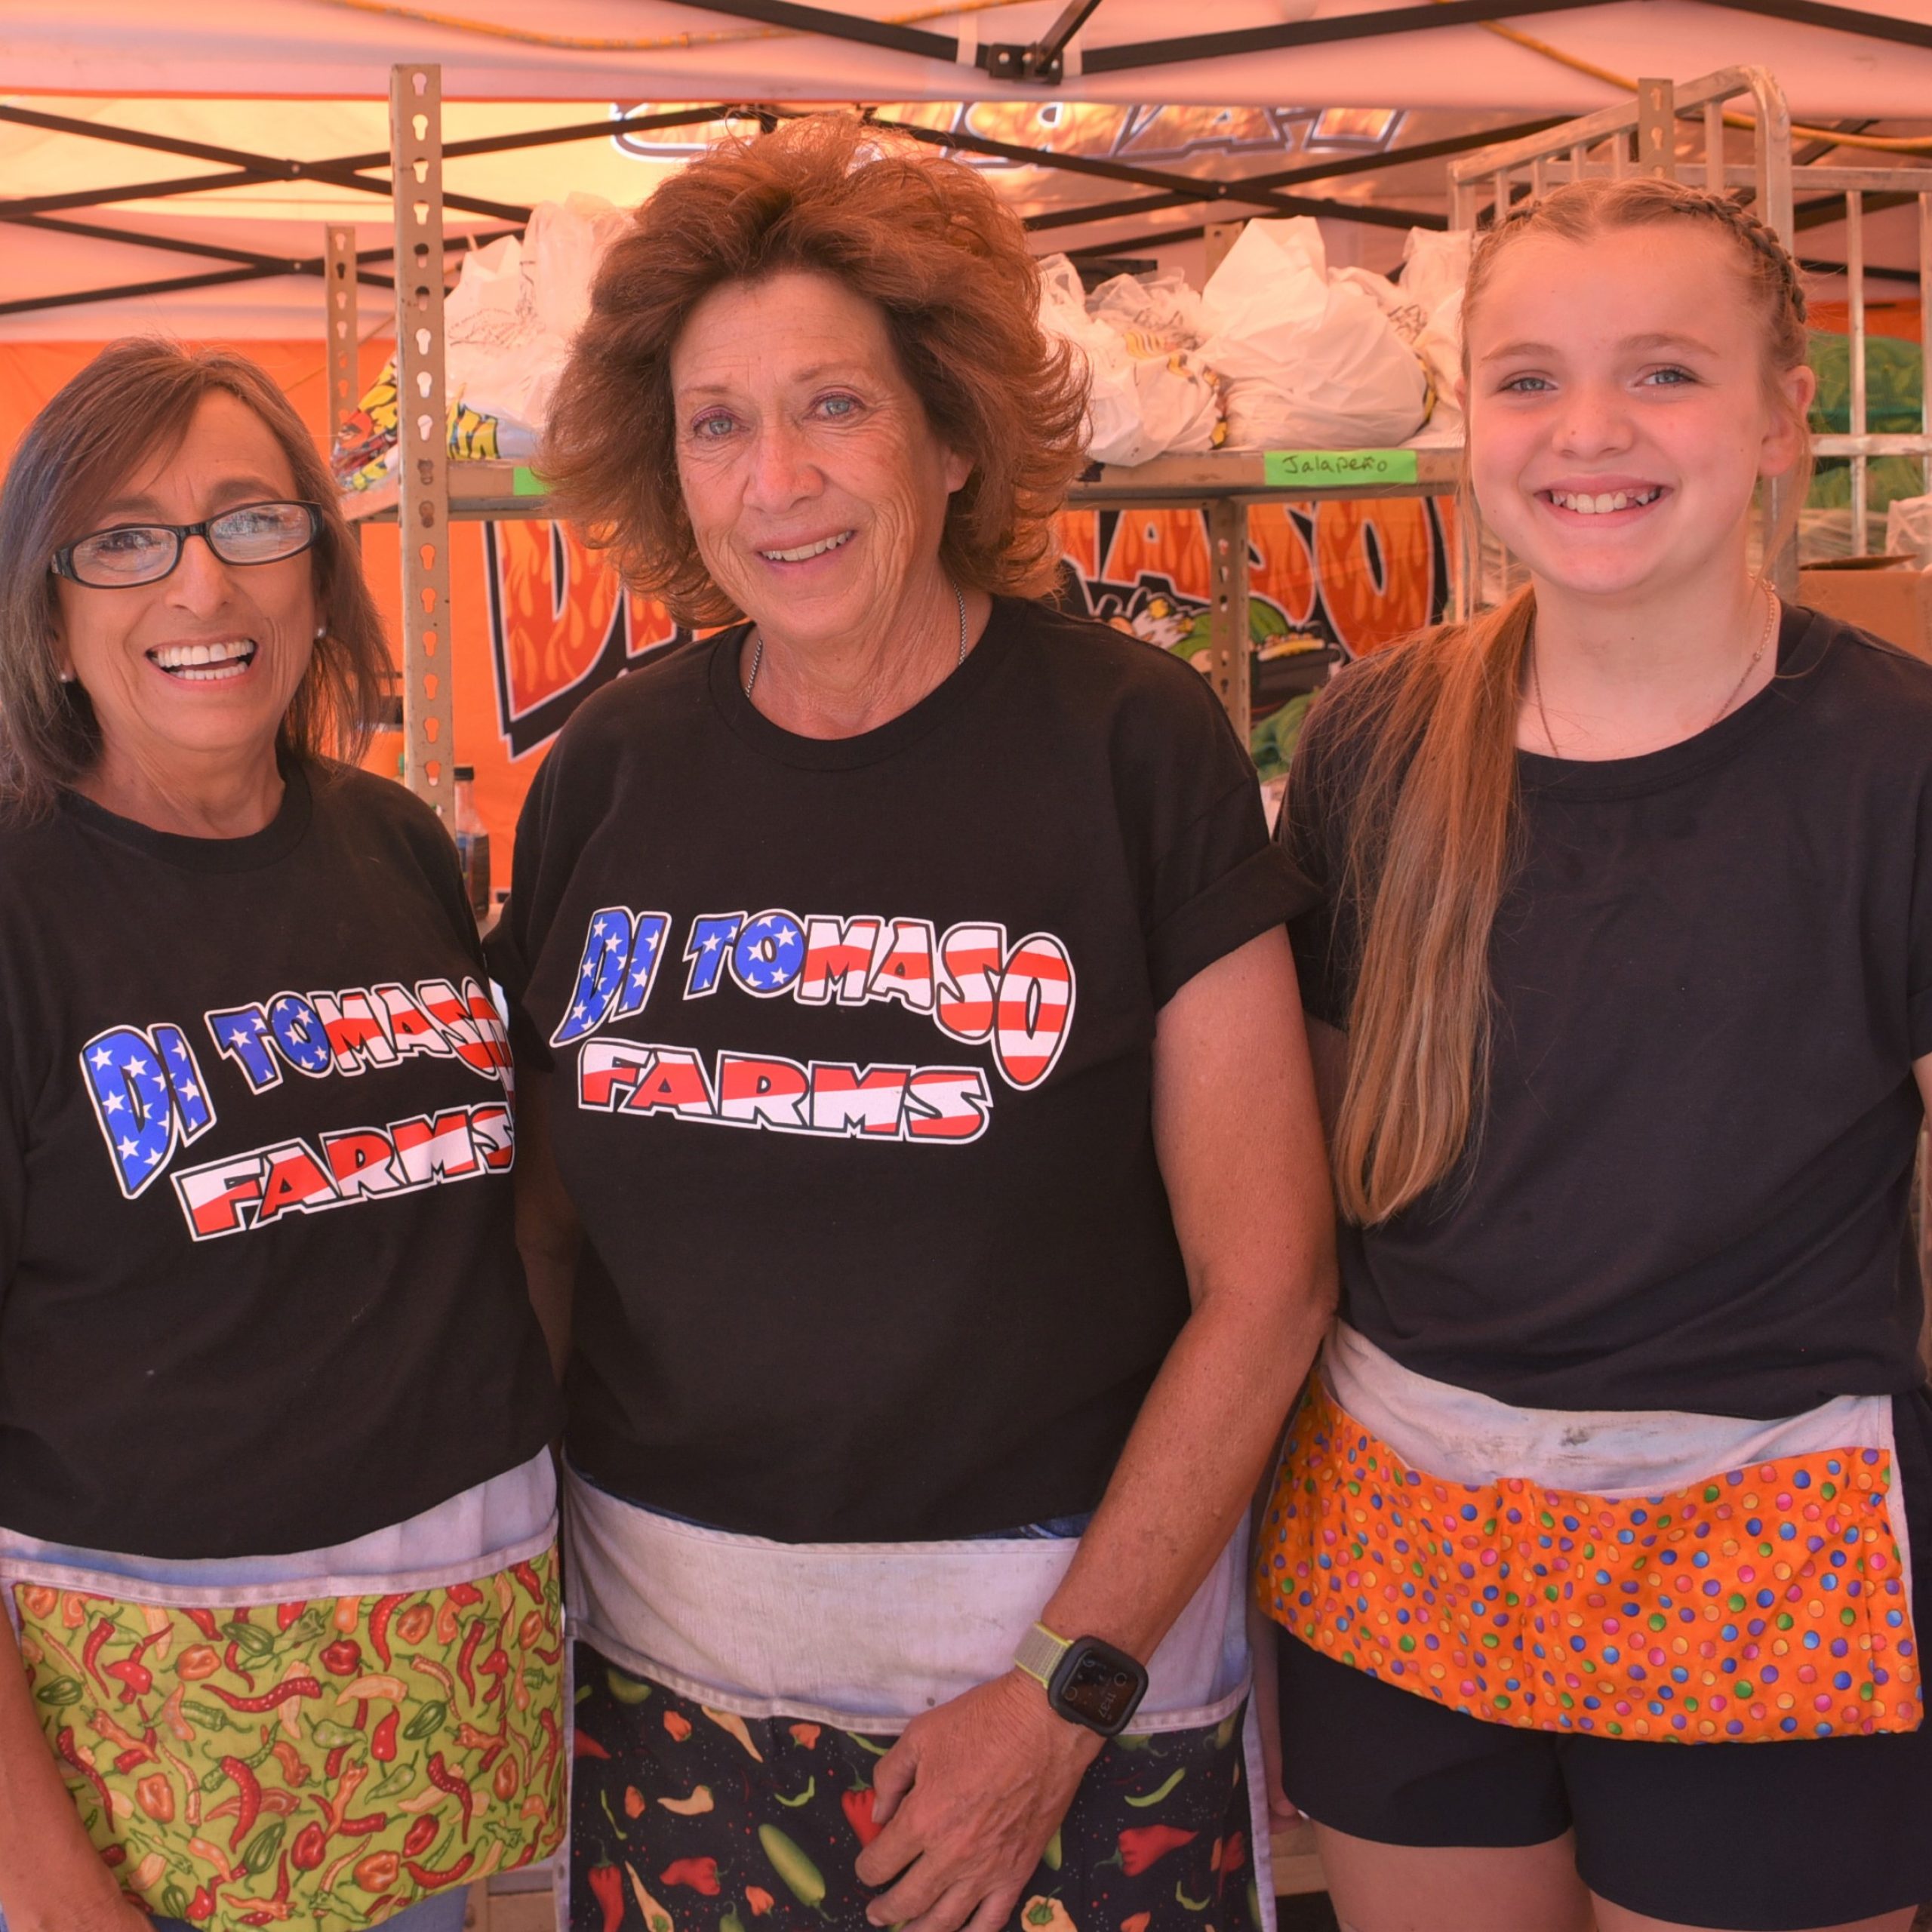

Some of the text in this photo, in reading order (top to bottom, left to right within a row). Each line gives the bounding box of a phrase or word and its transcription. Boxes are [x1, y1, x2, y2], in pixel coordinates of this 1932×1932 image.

[1282, 455, 1387, 474] Jalapeño
[549, 906, 1076, 1091] DI TOMASO
[79, 1024, 217, 1200] DI
[577, 1038, 993, 1145] FARMS
[170, 1102, 515, 1242] FARMS
